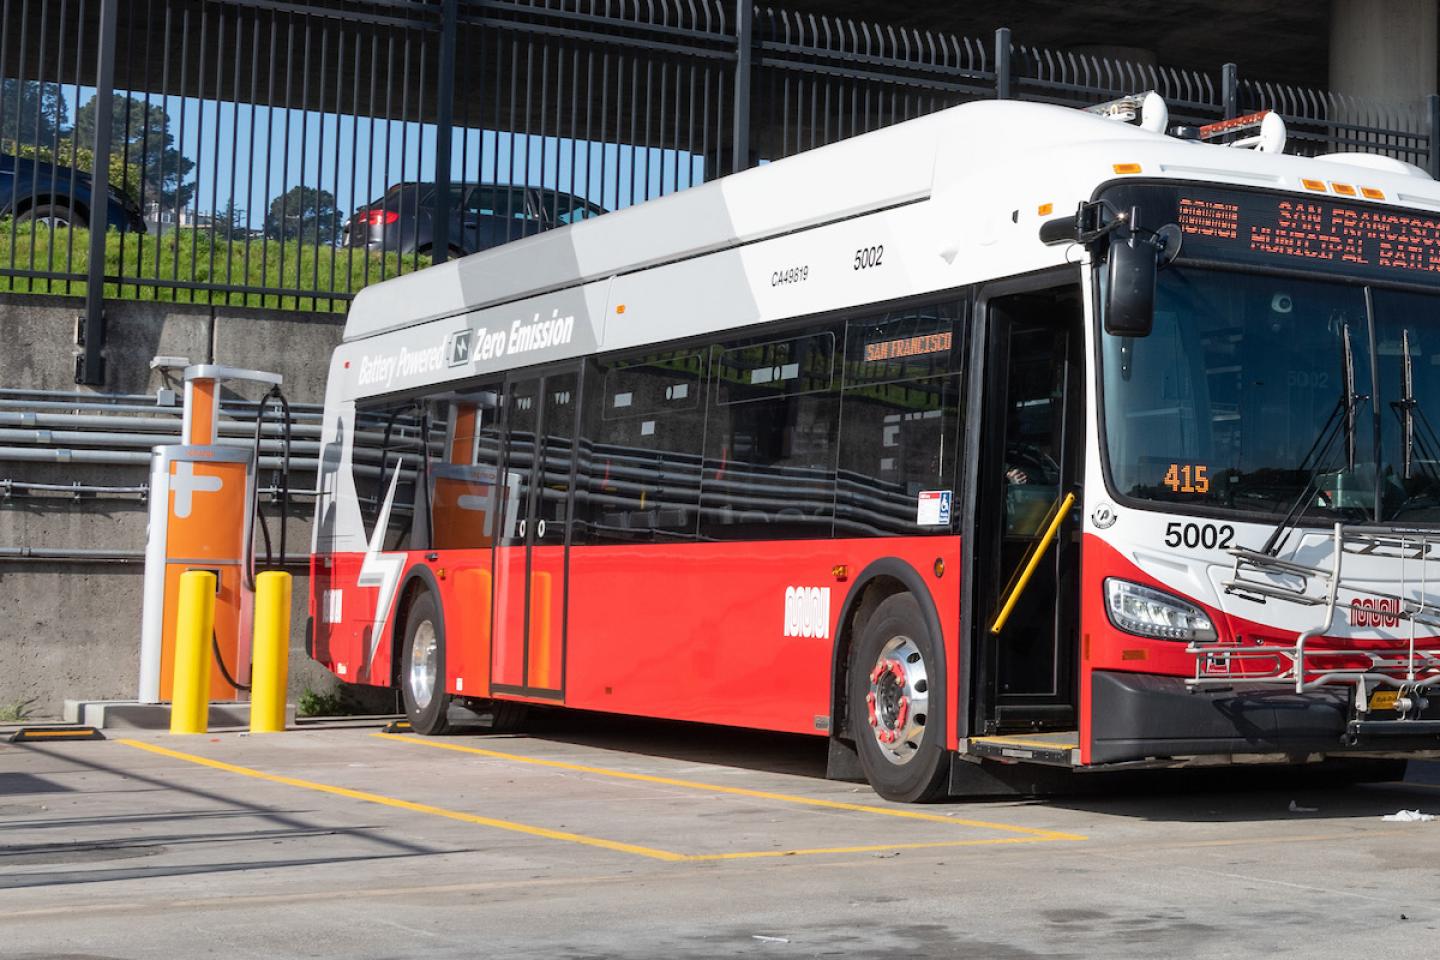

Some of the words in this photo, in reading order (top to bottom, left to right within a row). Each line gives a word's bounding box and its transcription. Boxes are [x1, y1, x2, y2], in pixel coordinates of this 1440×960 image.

[1278, 202, 1322, 232] SAN
[854, 245, 884, 270] 5002
[1251, 226, 1368, 264] MUNICIPAL
[771, 266, 808, 287] CA49819
[473, 327, 506, 361] Zero
[507, 309, 575, 355] Emission
[866, 343, 888, 360] SAN
[891, 333, 952, 357] FRANCISCO
[358, 355, 397, 387] Battery
[396, 335, 447, 376] Powered
[1164, 464, 1209, 493] 415
[1164, 522, 1235, 550] 5002
